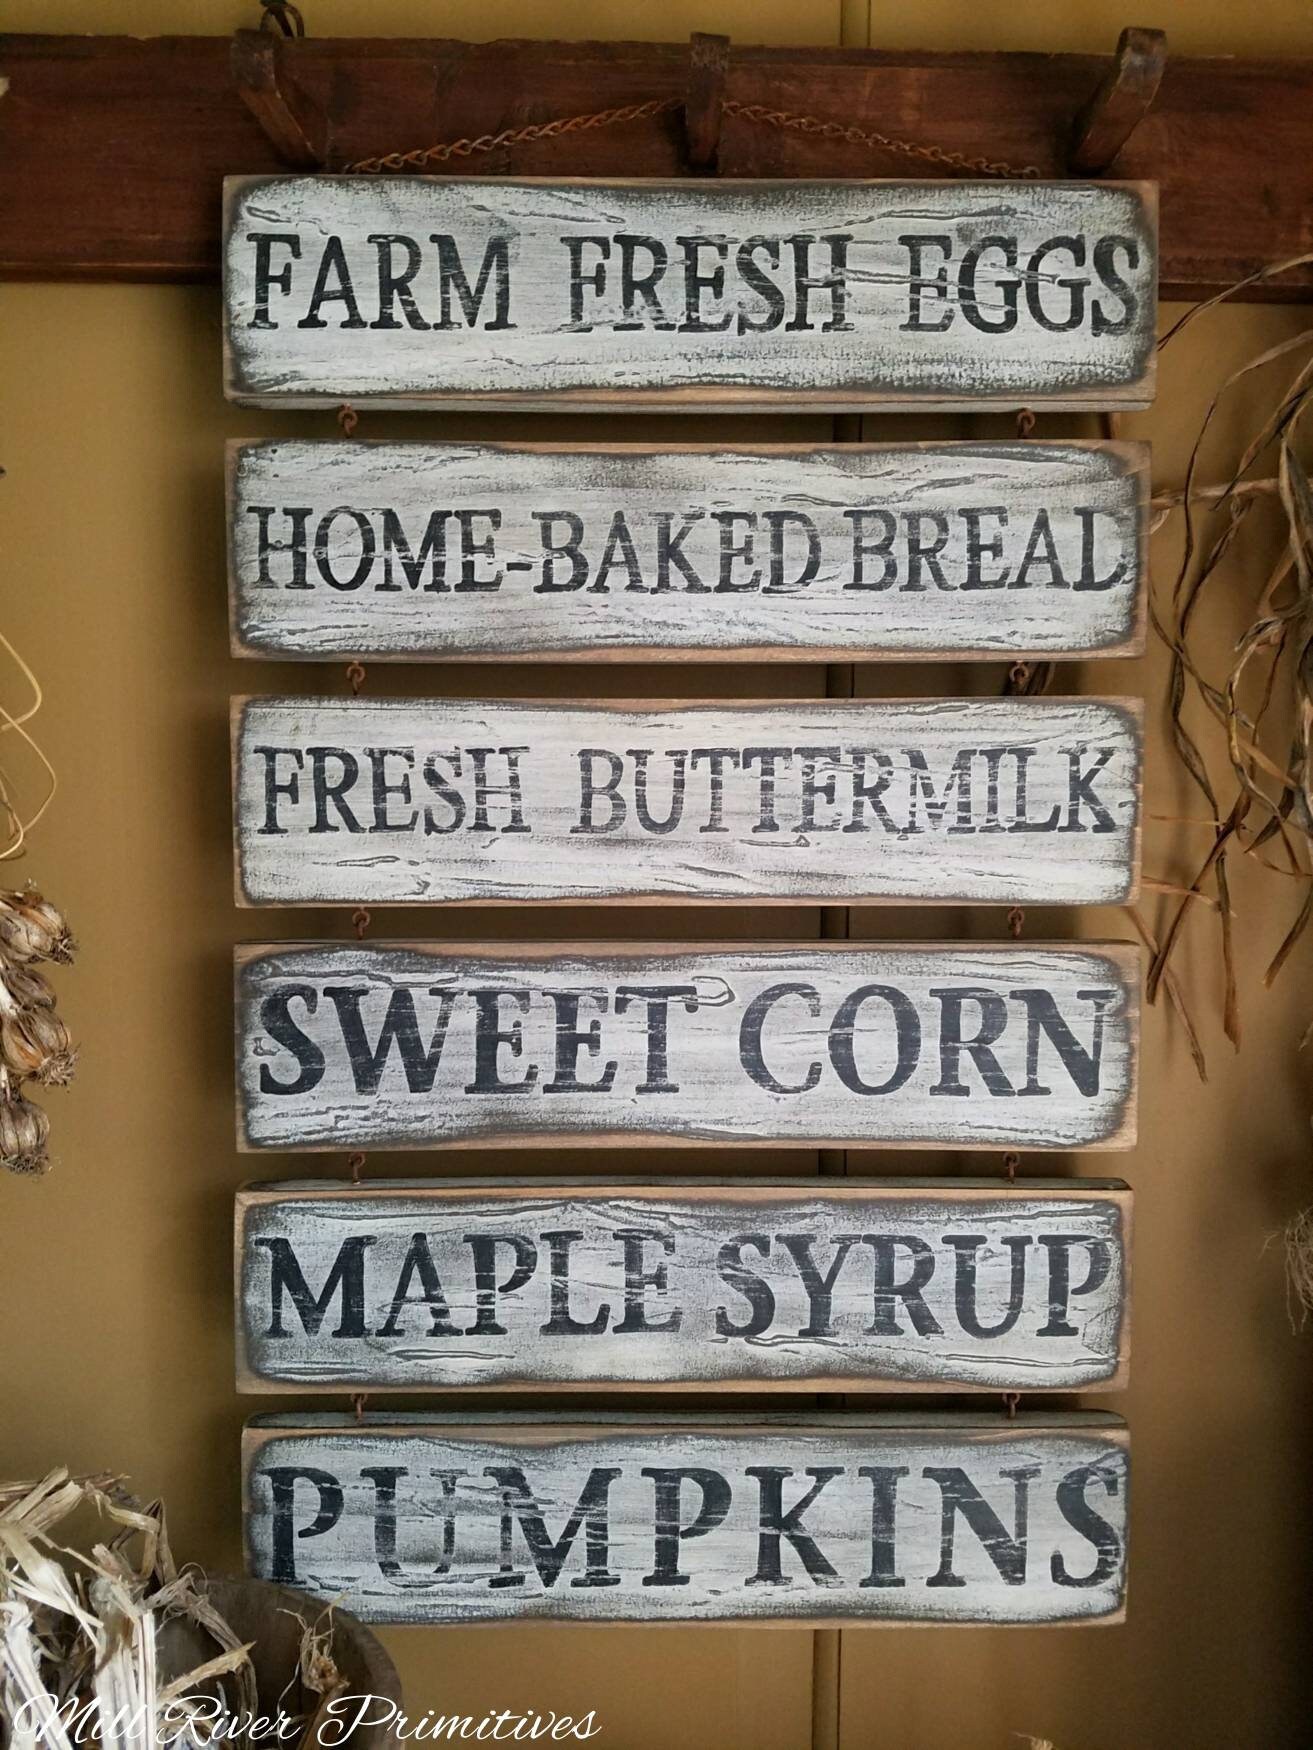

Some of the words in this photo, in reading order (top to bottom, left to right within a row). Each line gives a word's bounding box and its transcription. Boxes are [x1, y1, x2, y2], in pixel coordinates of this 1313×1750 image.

[249, 233, 517, 331] FARM
[562, 235, 853, 335] FRESH
[899, 231, 1142, 335] EGGS
[247, 505, 820, 592] HOME-BAKED
[844, 506, 1127, 589] BREAD
[255, 745, 530, 834] FRESH
[570, 746, 1119, 834] BUTTERMILK
[260, 980, 699, 1095] SWEET
[741, 984, 1112, 1097] CORN
[258, 1228, 681, 1338] MAPLE
[716, 1234, 1114, 1340] SYRUP
[261, 1465, 1123, 1589] PUMPKINS
